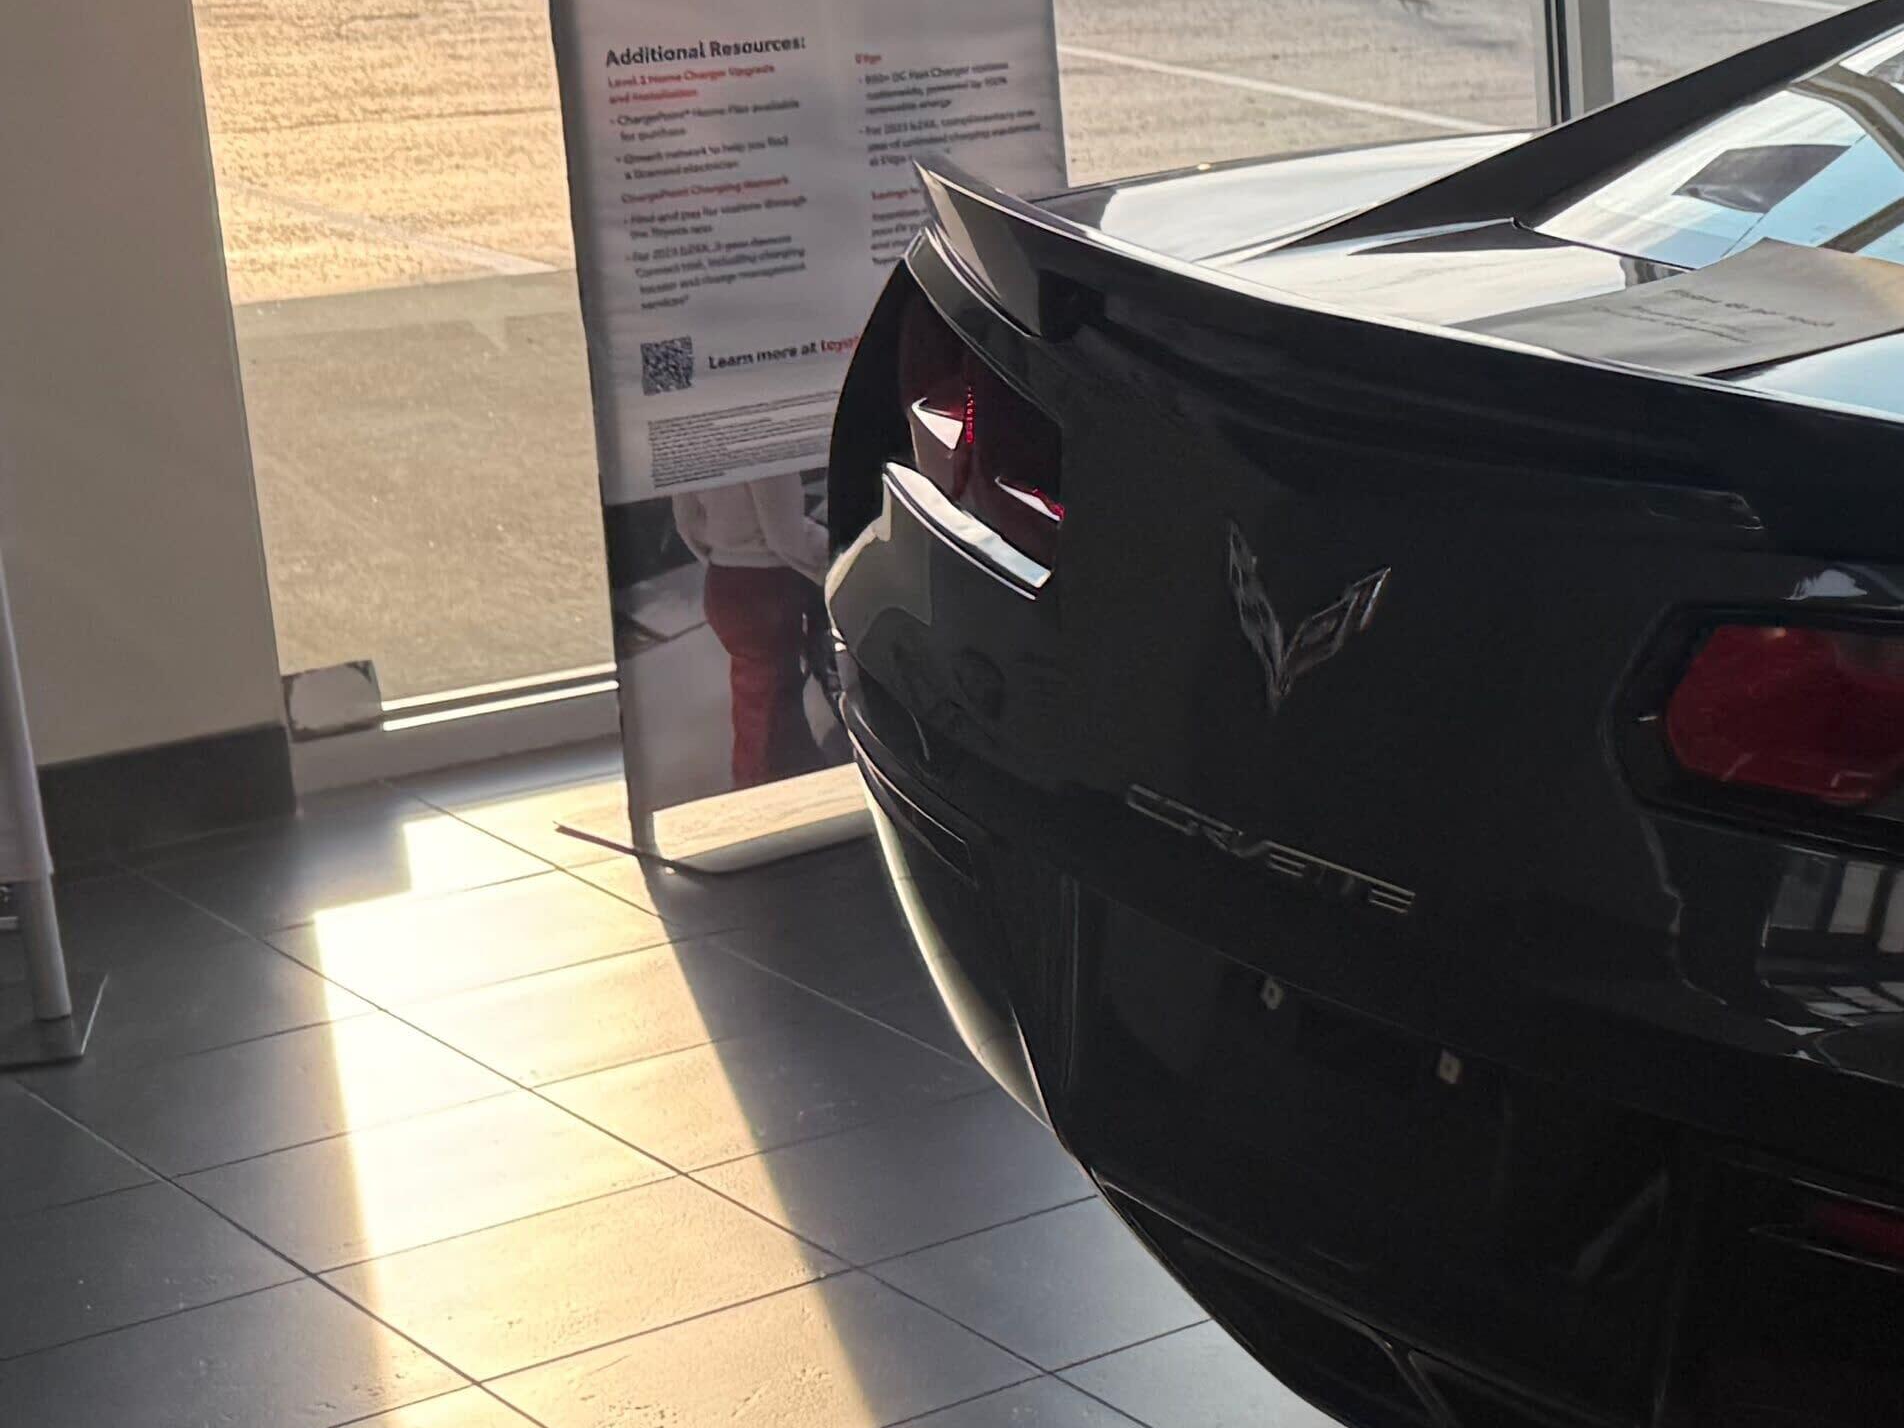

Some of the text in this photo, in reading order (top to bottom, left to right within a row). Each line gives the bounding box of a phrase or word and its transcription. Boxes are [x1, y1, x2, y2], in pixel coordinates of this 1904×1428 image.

[606, 37, 806, 67] Additional Resources:
[708, 353, 753, 370] Learn
[756, 346, 798, 362] more
[802, 341, 816, 356] at
